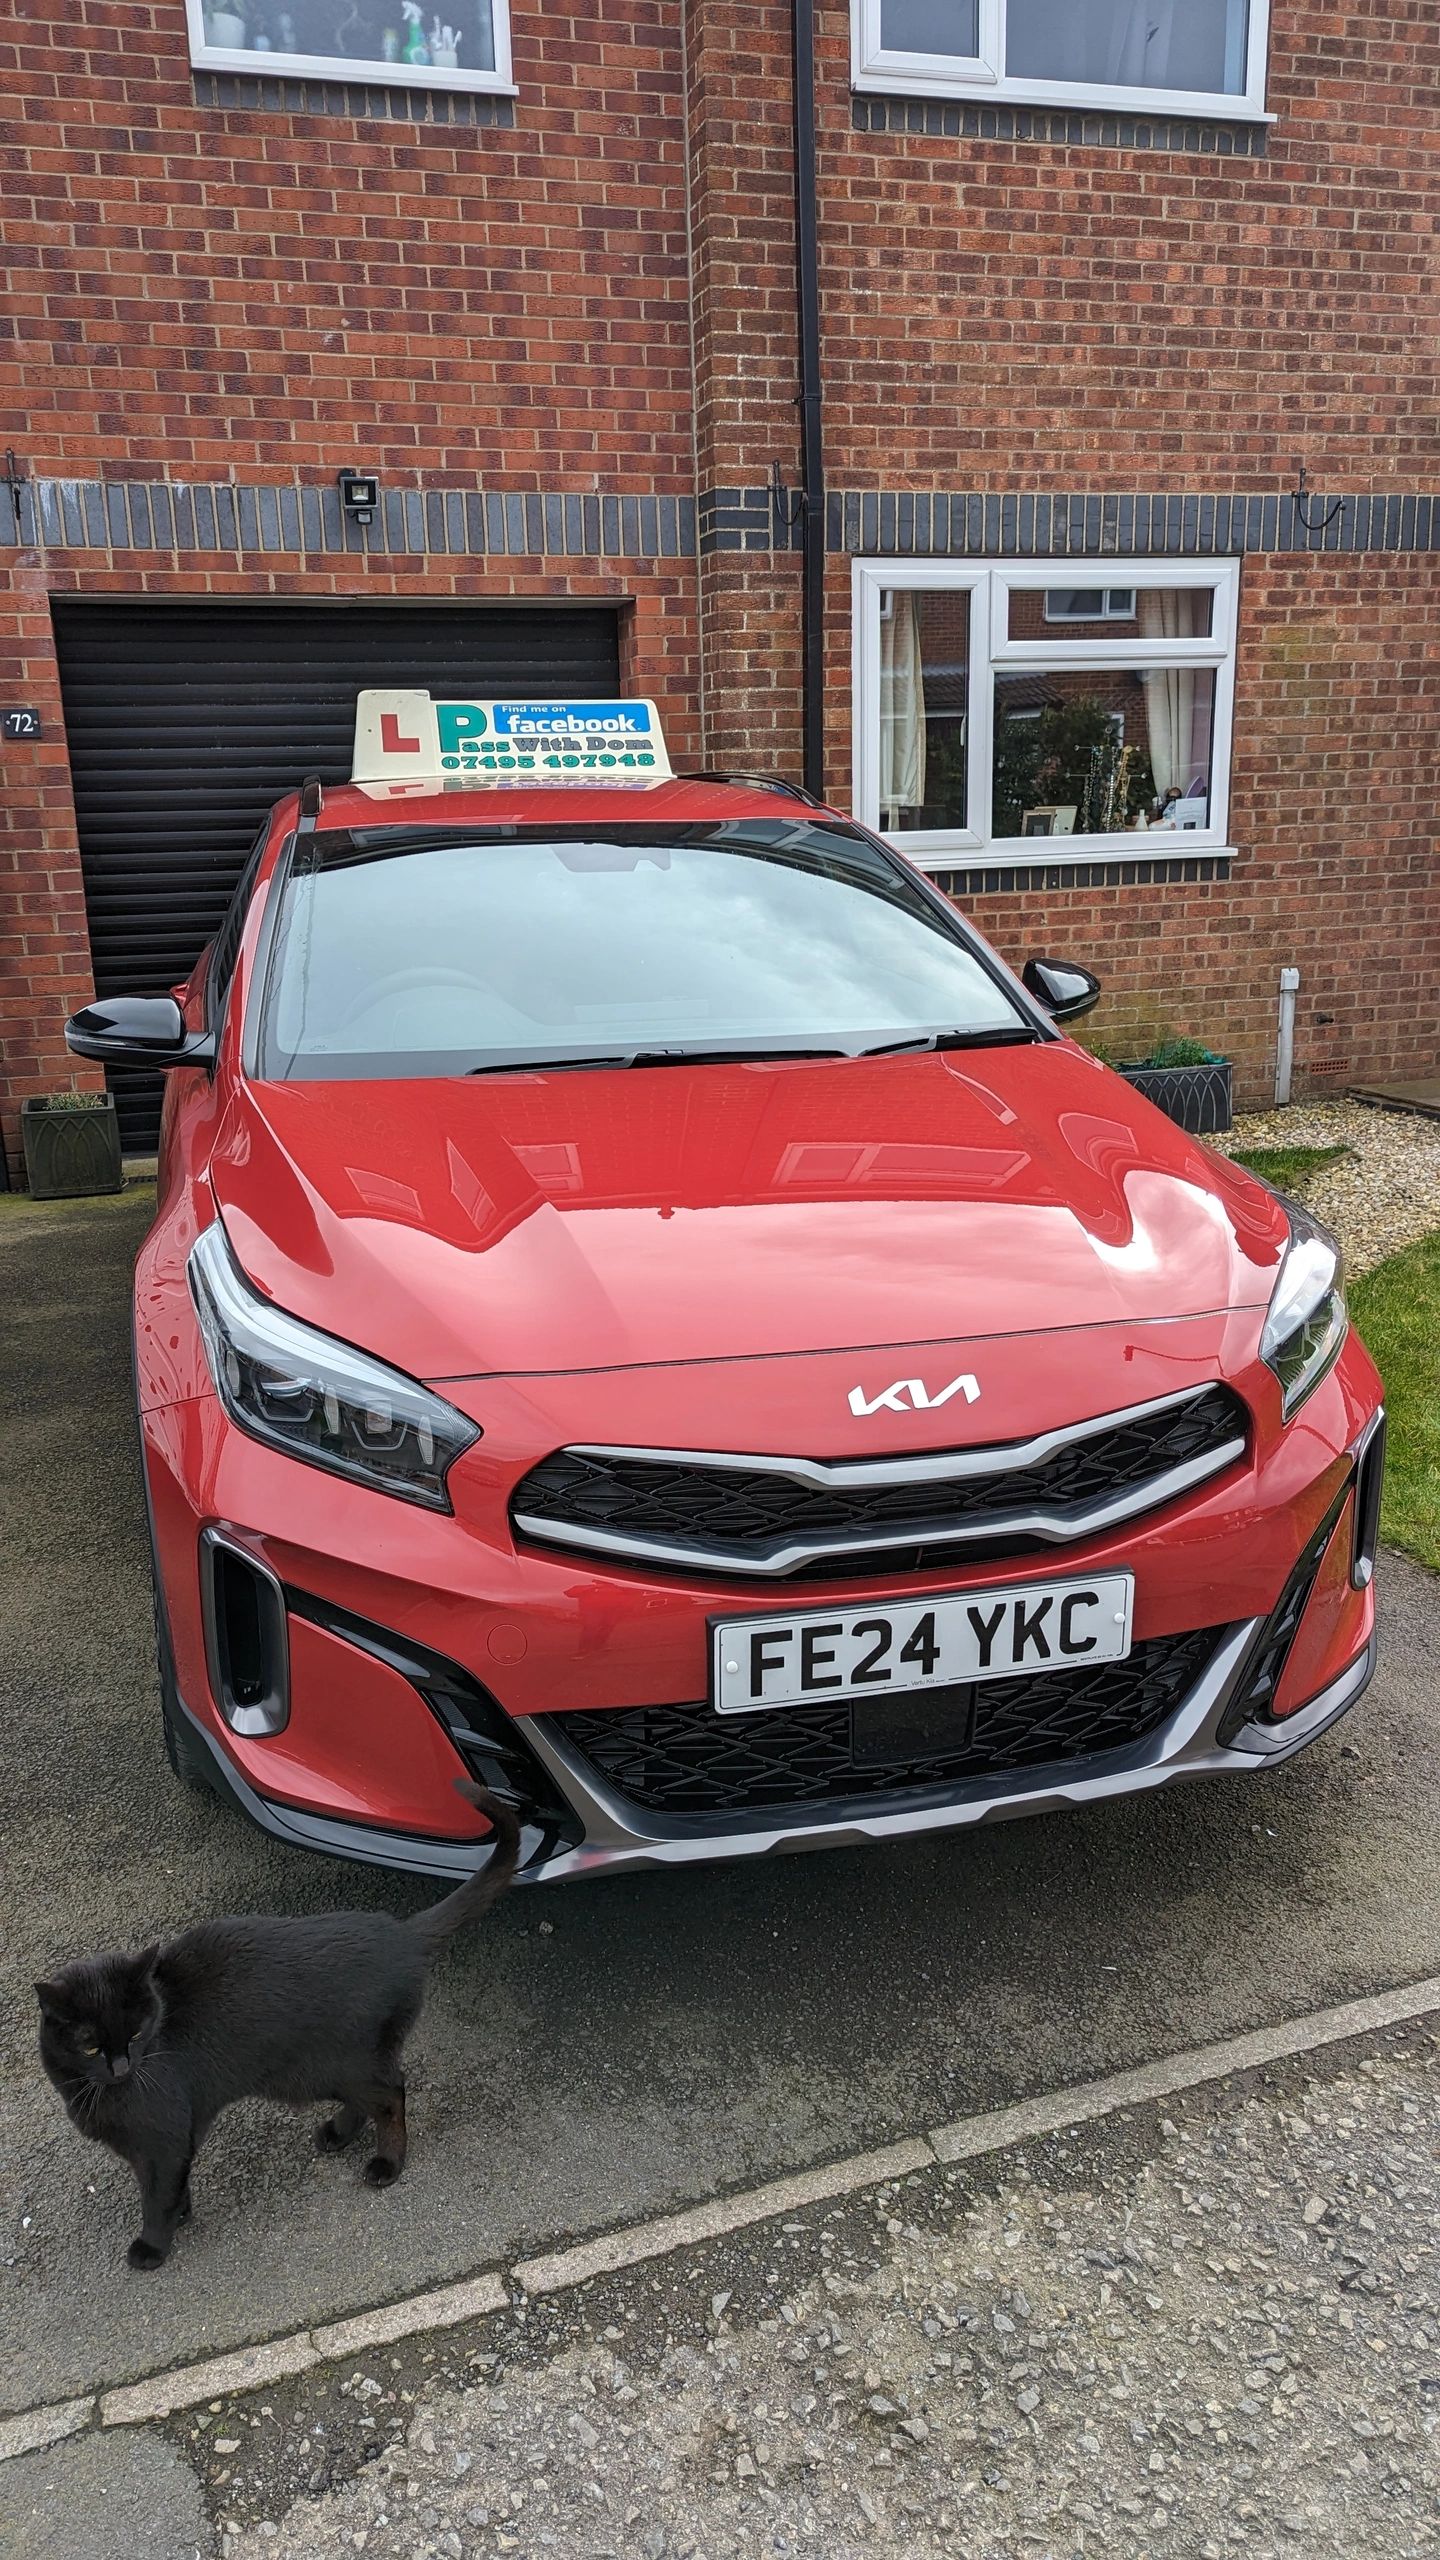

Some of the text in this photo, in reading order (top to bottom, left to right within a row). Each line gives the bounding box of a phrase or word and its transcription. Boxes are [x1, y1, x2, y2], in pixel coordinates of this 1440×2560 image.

[502, 705, 527, 713] Find
[10, 713, 34, 732] 72
[507, 714, 636, 733] facebook
[380, 713, 421, 753] L
[512, 737, 582, 752] With
[586, 736, 654, 750] Dom
[441, 754, 656, 769] 07495 497948
[847, 1373, 981, 1417] KIA
[750, 1591, 1100, 1698] FE24 YKC
